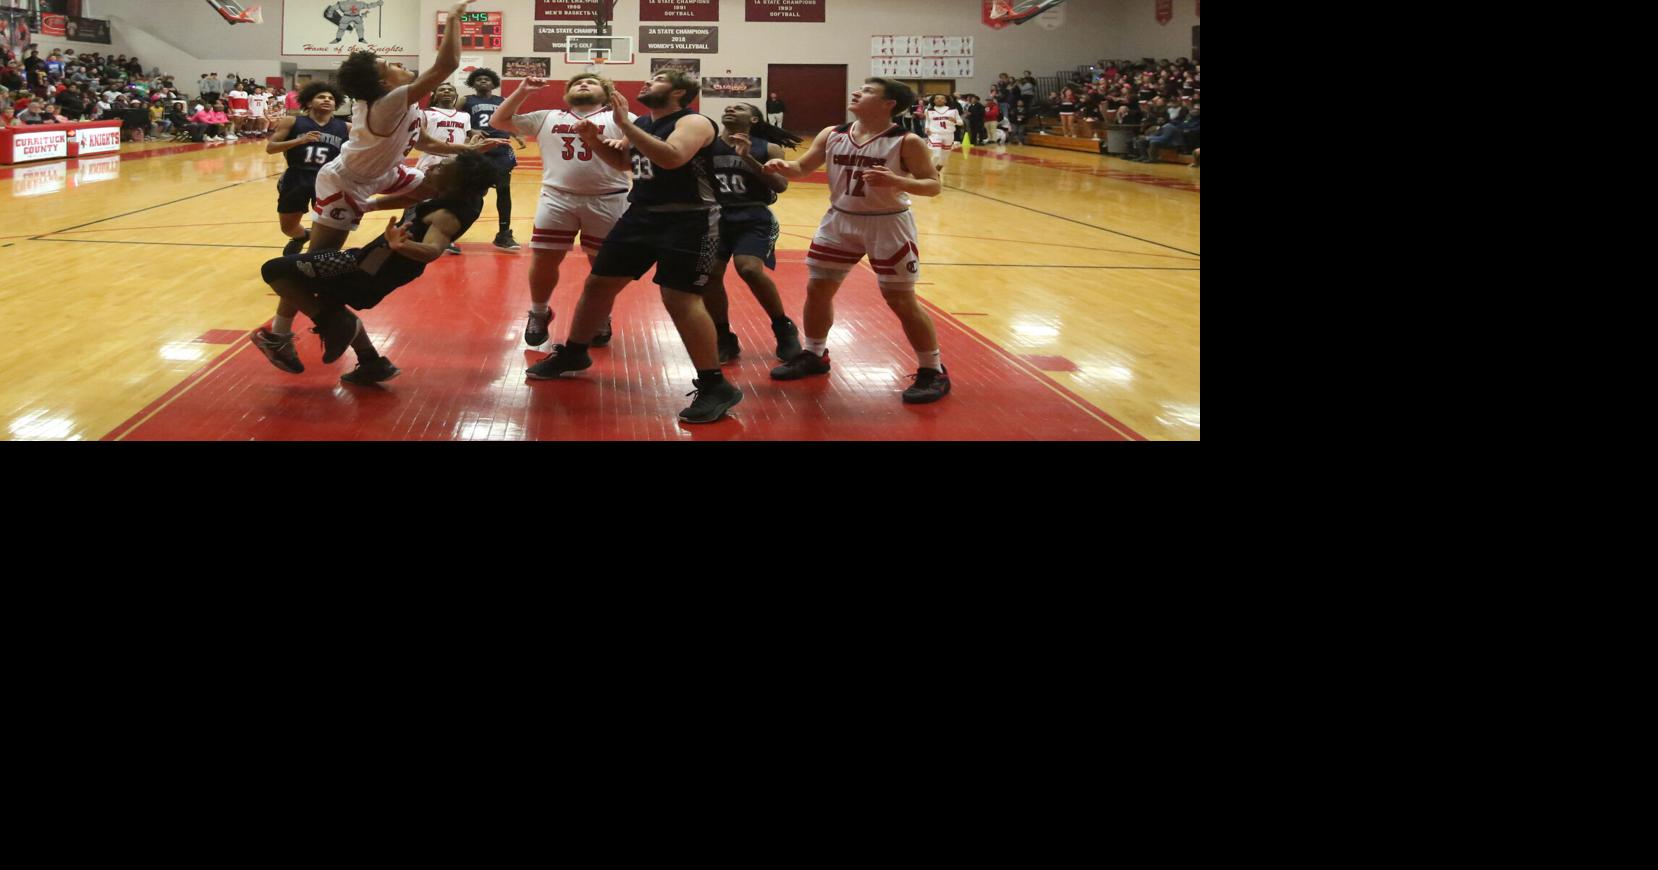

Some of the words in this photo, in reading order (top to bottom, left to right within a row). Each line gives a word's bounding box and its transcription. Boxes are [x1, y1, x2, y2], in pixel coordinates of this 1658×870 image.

[461, 13, 488, 22] 5:45
[302, 44, 329, 52] Home
[334, 45, 344, 54] of
[367, 44, 404, 54] Knights
[15, 135, 65, 148] CURRITUCK
[89, 131, 120, 148] KNIGHTS
[23, 143, 58, 155] COUNTY
[304, 145, 329, 164] 15
[561, 136, 593, 161] 33
[715, 173, 747, 193] 30
[844, 168, 866, 197] 12
